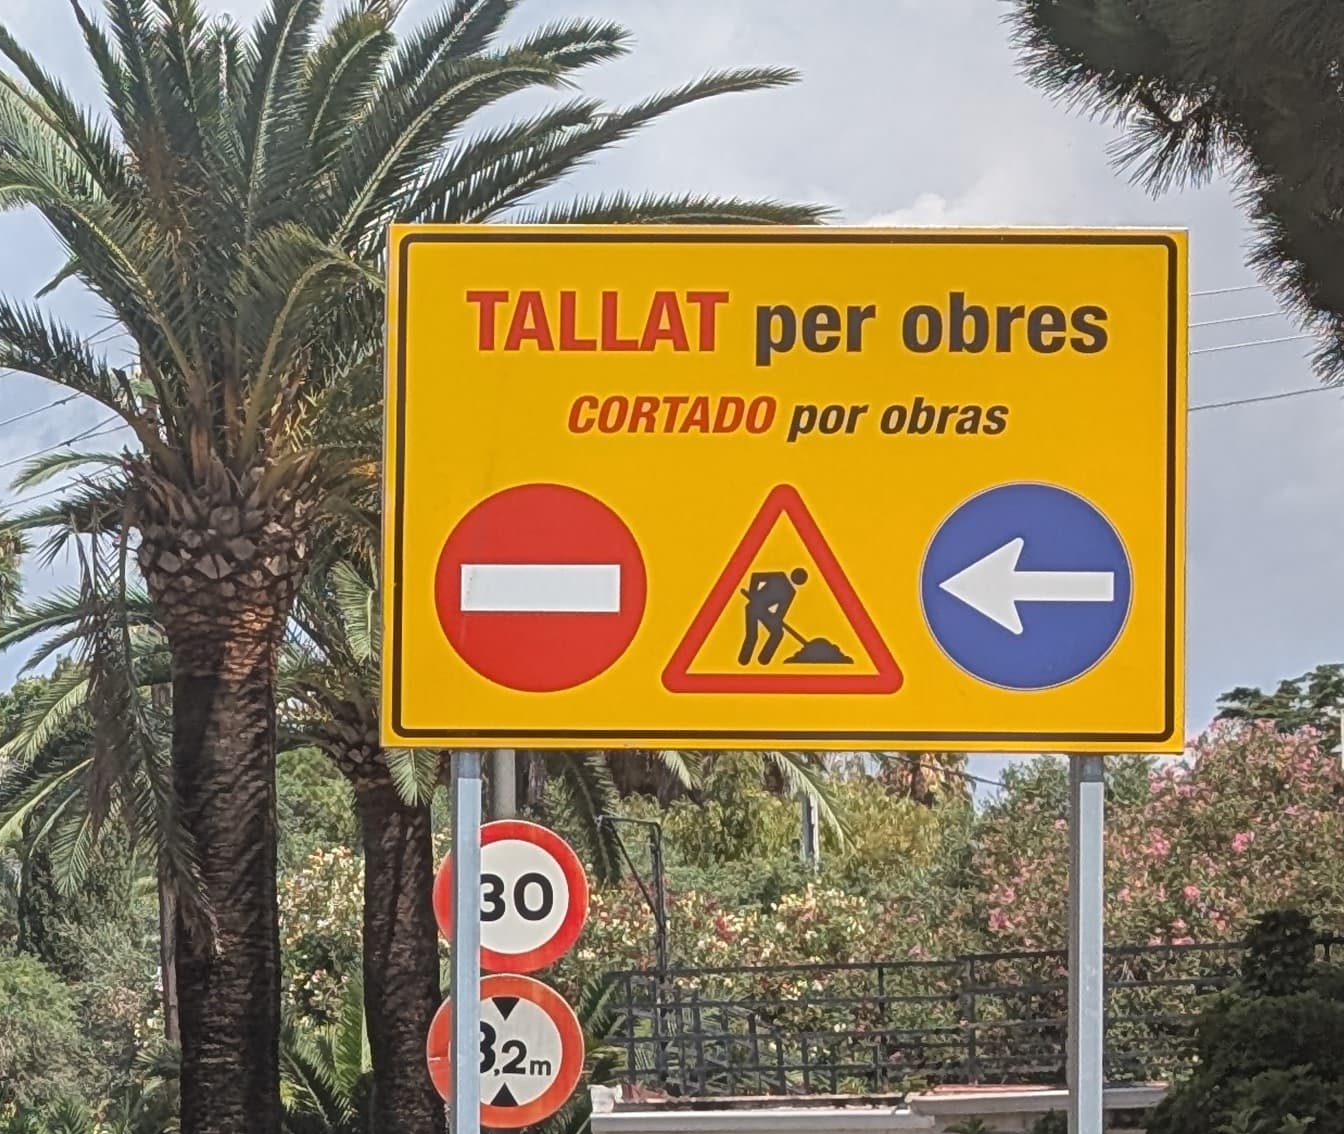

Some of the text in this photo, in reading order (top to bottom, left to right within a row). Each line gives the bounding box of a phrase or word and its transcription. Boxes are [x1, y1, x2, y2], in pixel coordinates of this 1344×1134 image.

[466, 291, 1109, 366] TALLAT per obres
[567, 395, 1009, 442] CORTADO por obras
[479, 872, 554, 921] 30
